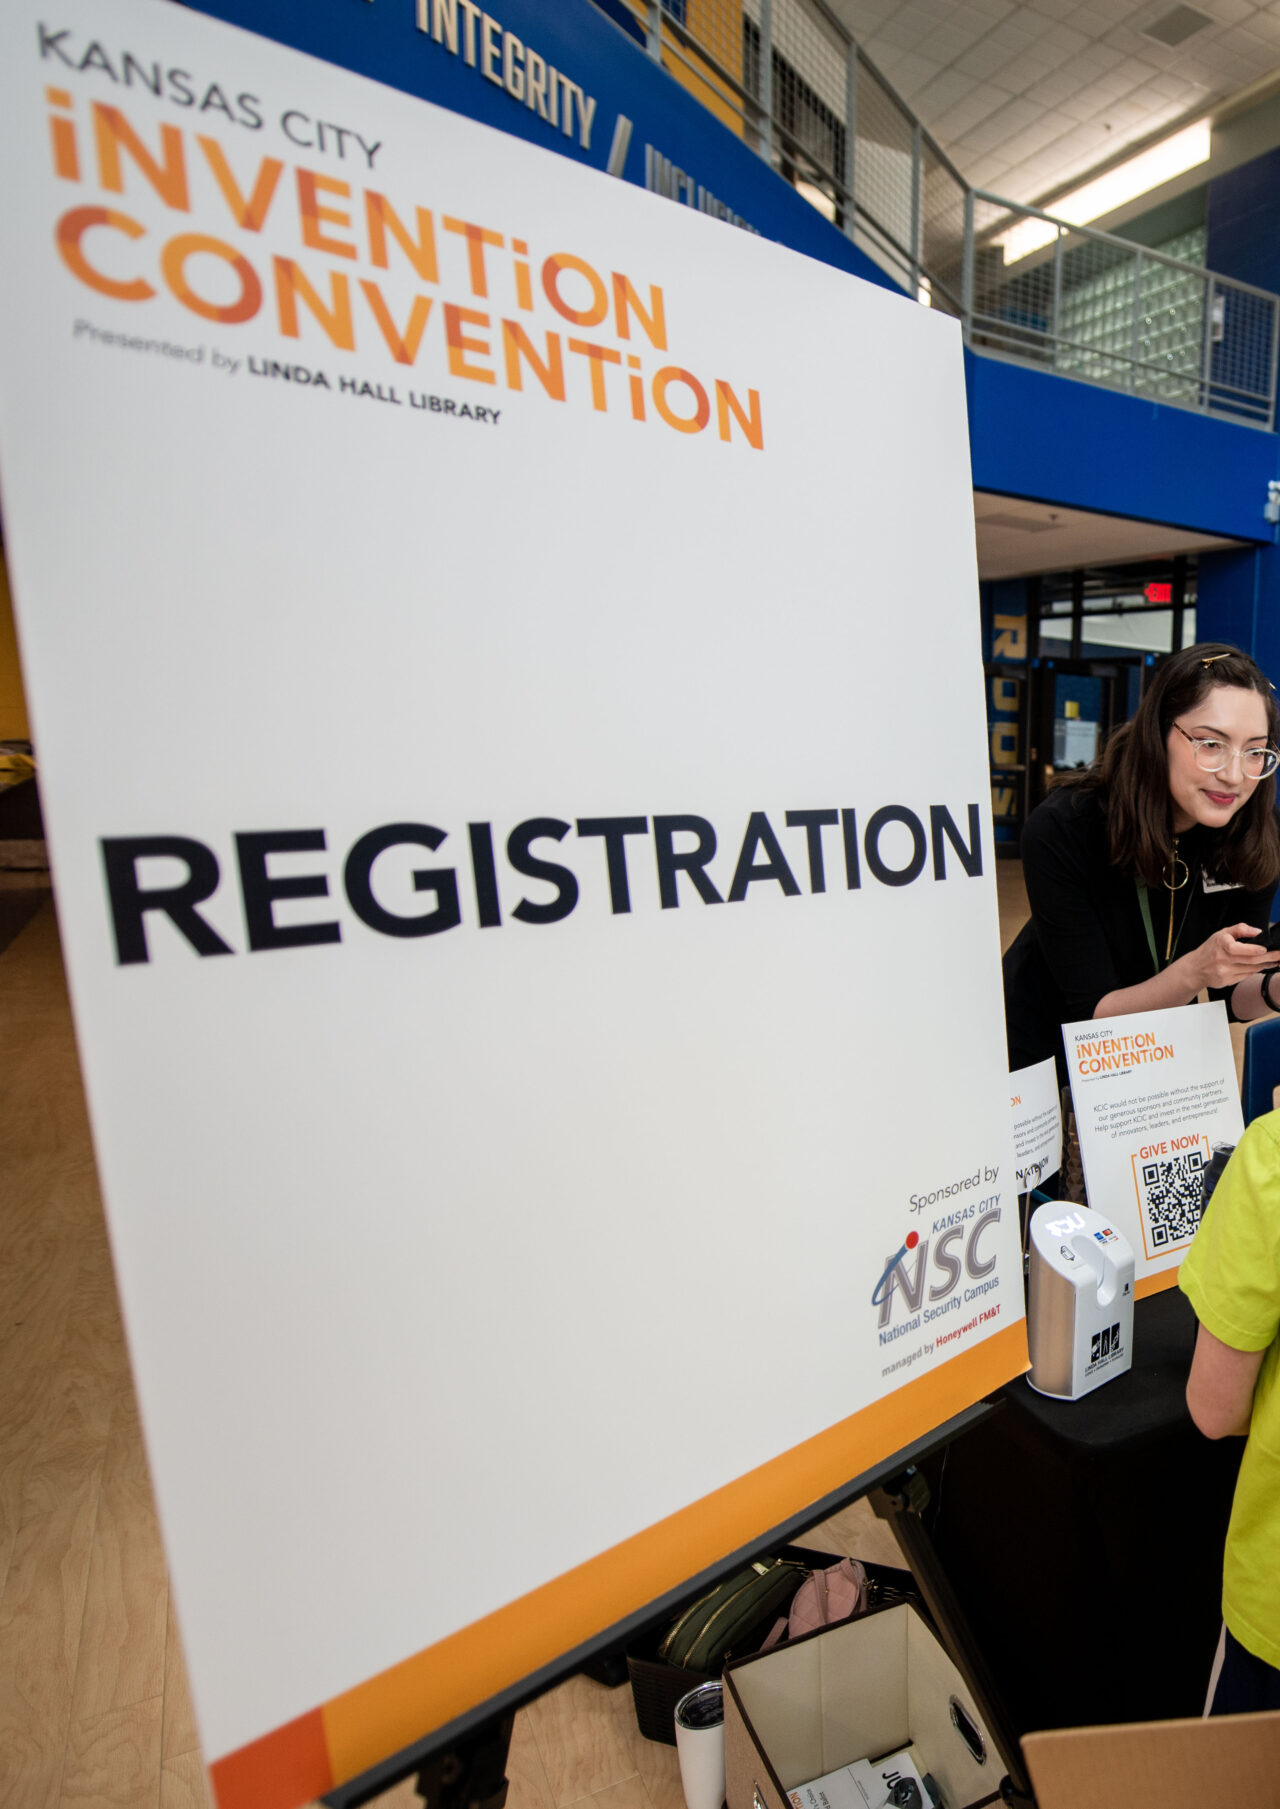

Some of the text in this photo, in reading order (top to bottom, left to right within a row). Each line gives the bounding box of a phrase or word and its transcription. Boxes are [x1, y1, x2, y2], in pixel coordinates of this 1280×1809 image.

[36, 20, 383, 169] KANSAS CITY
[71, 318, 502, 425] Presented by LINDA HALL LIBRARY
[98, 803, 984, 968] REGISTRATION
[1075, 1030, 1114, 1042] KANSAS CITY
[1094, 1124, 1108, 1134] Help
[1109, 1118, 1132, 1129] support
[1148, 1111, 1159, 1120] and
[1159, 1108, 1175, 1117] invest
[1181, 1102, 1190, 1112] the
[1191, 1101, 1202, 1110] next
[1203, 1096, 1229, 1108] generation
[1098, 1114, 1108, 1122] our
[1109, 1107, 1136, 1120] generous
[1136, 1102, 1160, 1113] sponsors
[1162, 1098, 1172, 1107] and
[1173, 1094, 1201, 1105] community
[1110, 1100, 1128, 1110] would
[1128, 1097, 1138, 1105] not
[1138, 1095, 1146, 1103] be
[1147, 1090, 1169, 1102] possible
[1170, 1086, 1190, 1096] without
[1190, 1083, 1198, 1091] the
[1199, 1080, 1219, 1091] support
[1111, 1131, 1117, 1139] of
[1171, 1116, 1182, 1124] and
[1139, 1133, 1200, 1160] GIVE NOW
[909, 1166, 1000, 1215] Sponsored by
[932, 1193, 1001, 1234] KANSAS CITY
[879, 1276, 1000, 1347] National Security Campus
[882, 1303, 1002, 1377] managed by Honeywell FM&T
